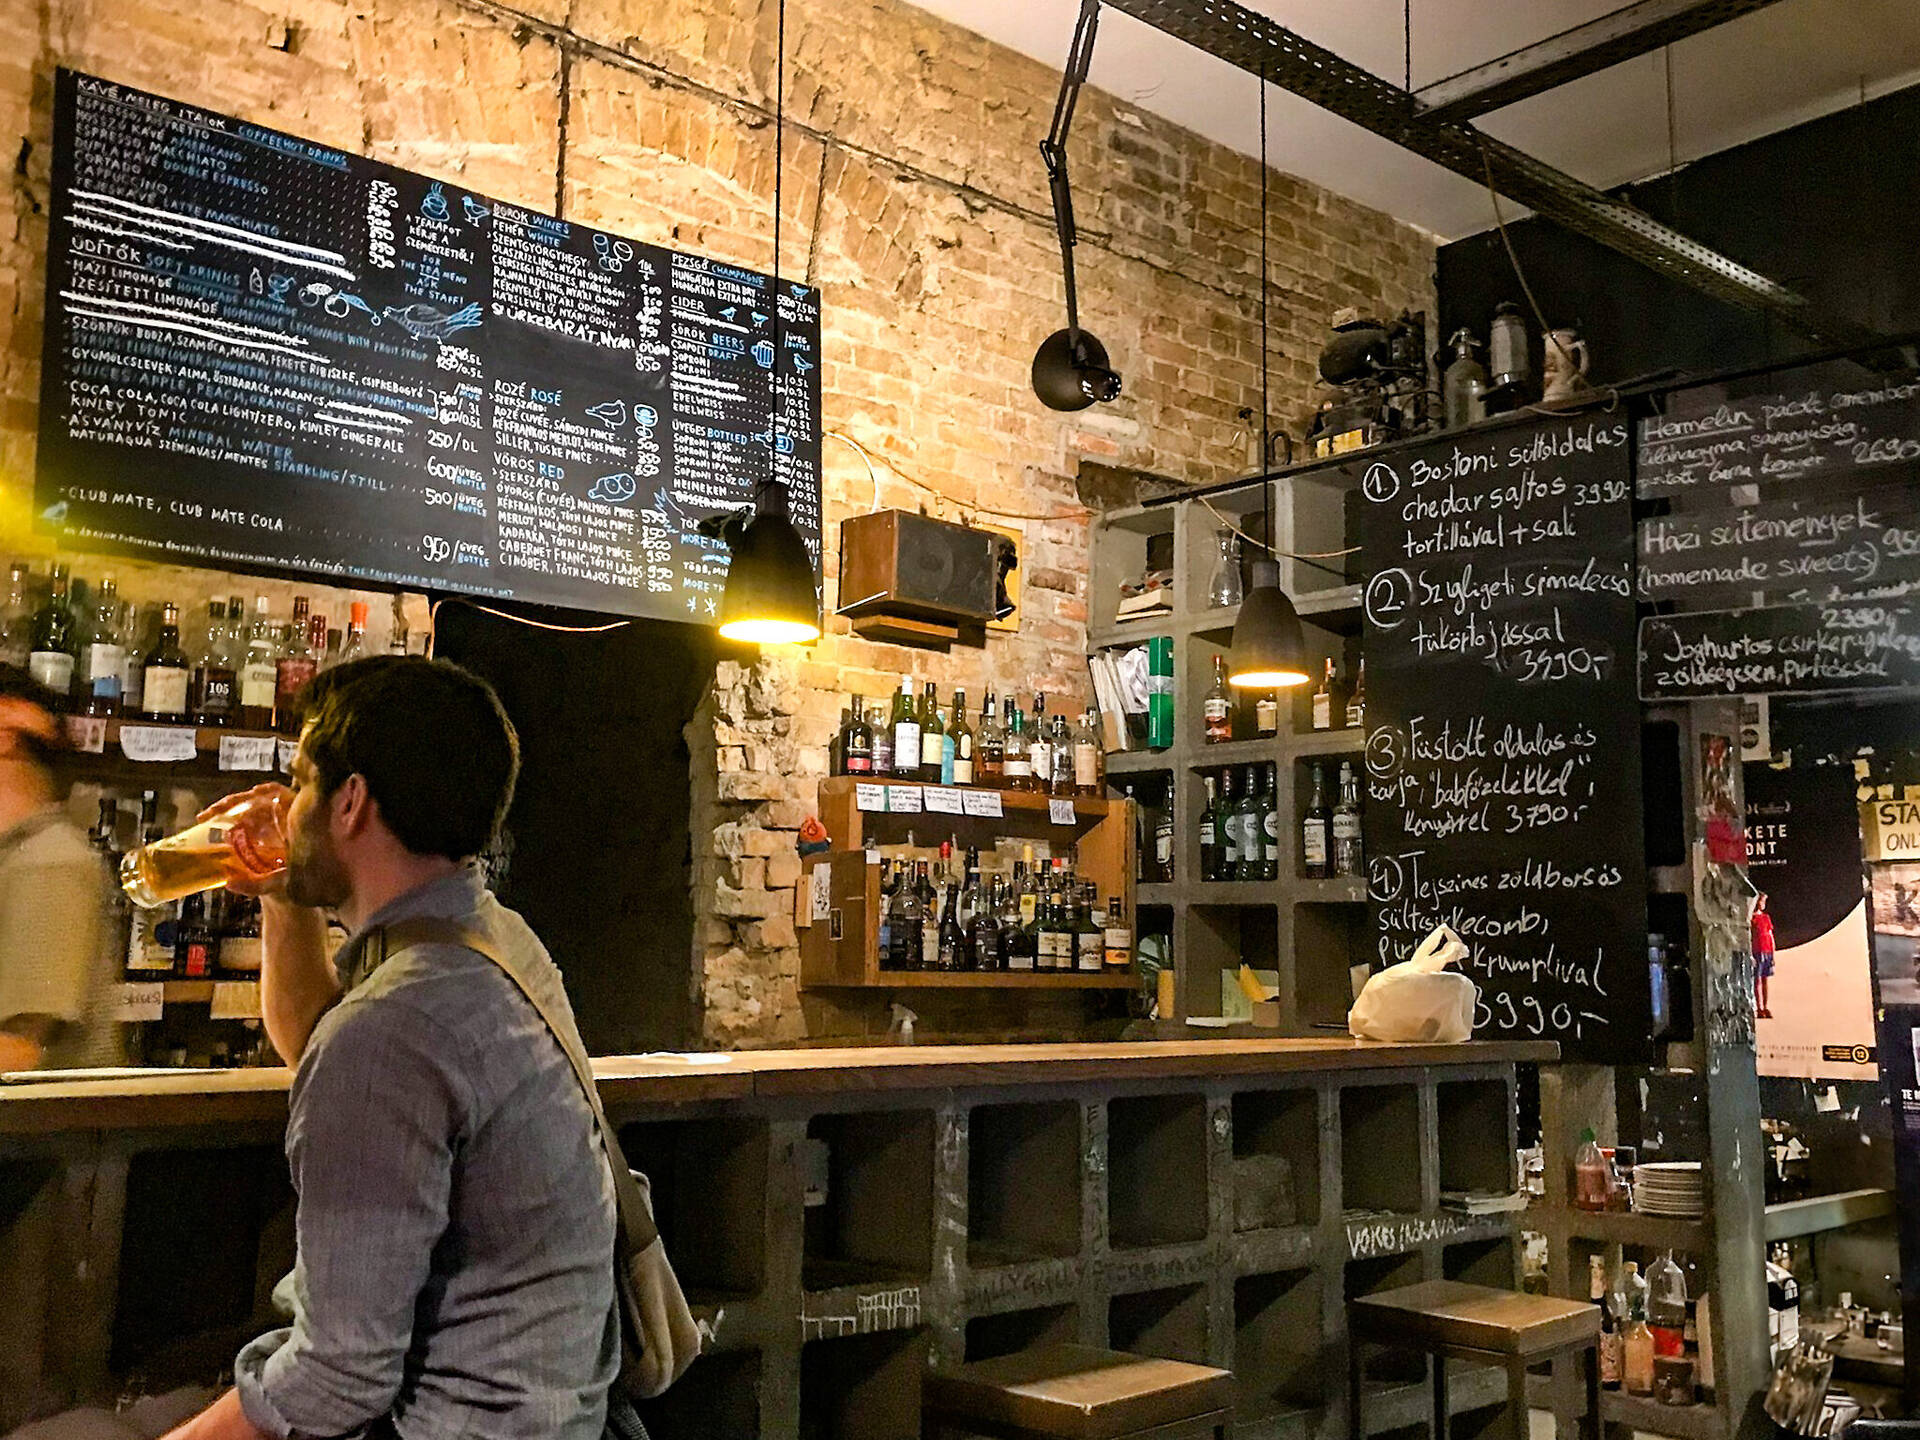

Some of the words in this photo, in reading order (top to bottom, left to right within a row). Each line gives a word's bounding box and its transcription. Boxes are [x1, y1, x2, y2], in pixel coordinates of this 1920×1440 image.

[409, 224, 437, 241] KÉRJE
[492, 218, 524, 237] FEHÉR
[527, 229, 560, 247] WHITE
[533, 215, 569, 234] WINES
[711, 264, 764, 285] CHAMPAGNE
[405, 284, 423, 295] THE
[671, 294, 705, 312] CIDER
[671, 338, 706, 356] CSAPOLT
[707, 348, 737, 361] DRAFT
[712, 332, 744, 351] BEERS
[635, 352, 660, 372] 850
[672, 350, 710, 367] SOPRONI
[672, 360, 710, 377] SOPRONI
[494, 379, 526, 398] ROZÉ
[530, 387, 562, 406] ROSÉ
[673, 390, 722, 409] EDELWEISS
[70, 379, 110, 396] COCA
[117, 388, 158, 404] COLA,
[161, 393, 187, 409] COCA
[190, 399, 218, 414] COLA
[299, 419, 339, 437] KINLEY
[70, 394, 125, 413] KINLEY
[138, 404, 186, 423] TONIC
[673, 402, 724, 420] EDELWEISS
[494, 404, 519, 419] ROZÉ
[637, 437, 659, 453] 500
[707, 427, 747, 444] BOTTLED
[168, 427, 232, 448] MINERAL
[241, 439, 293, 459] WATER
[673, 432, 708, 448] SOPRONI
[673, 443, 708, 459] SOPRONI
[539, 461, 564, 480] RED
[674, 454, 710, 469] SOPRONI
[711, 461, 728, 472] IPA
[674, 465, 710, 480] SOPRONI
[1410, 445, 1498, 488] Bostoni
[499, 469, 559, 491] SZEKSZÁRD
[673, 478, 726, 496] HEINEKEN
[1402, 483, 1482, 522] chedar
[1490, 467, 1567, 511] sajtos
[68, 487, 107, 503] CLUB
[112, 493, 161, 512] MATE,
[170, 501, 202, 518] CLUB
[211, 508, 245, 524] MATE
[250, 513, 283, 531] COLA
[588, 527, 617, 541] PINCE
[681, 533, 707, 549] MORE
[1643, 521, 1700, 553] Házi
[577, 540, 603, 554] LAJOS
[580, 569, 609, 584] LAJOS
[1638, 557, 1768, 595] (homemade
[1777, 540, 1879, 582] sweets)
[1664, 630, 1774, 667] Joghurtos
[208, 682, 230, 695] 105
[1493, 723, 1566, 760] oldalas
[1886, 833, 1920, 851] ONL
